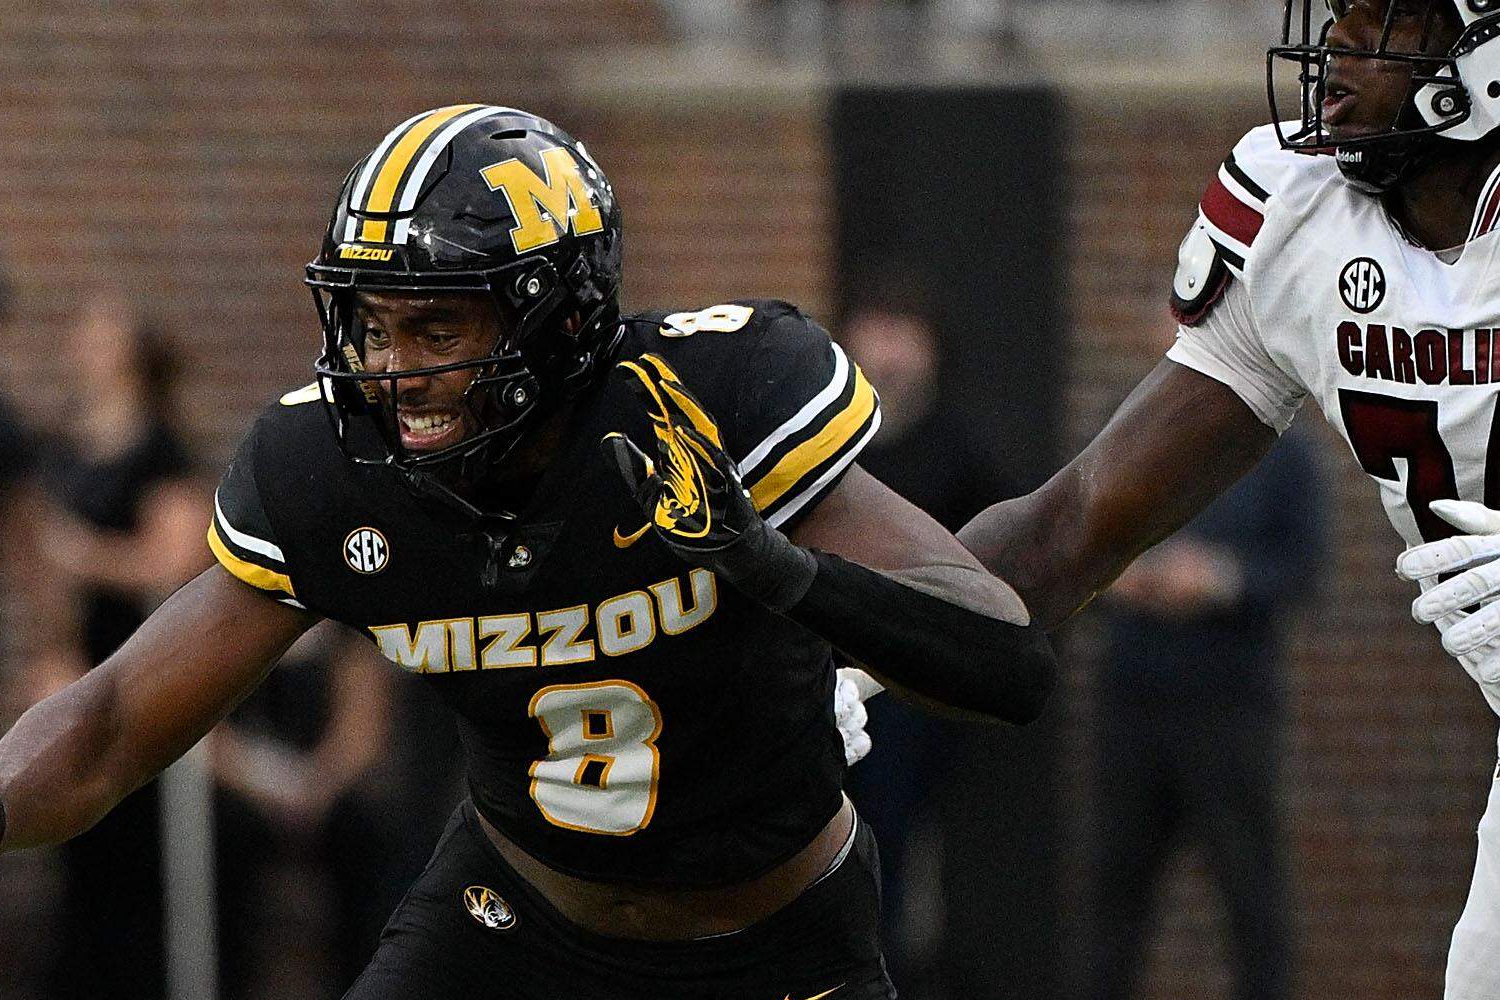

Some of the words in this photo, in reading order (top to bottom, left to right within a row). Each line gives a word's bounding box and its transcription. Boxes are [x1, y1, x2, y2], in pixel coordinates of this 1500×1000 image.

[479, 147, 604, 254] M
[340, 248, 393, 262] MIZZOU
[1343, 262, 1381, 309] SEC
[343, 343, 378, 404] MIZOU
[1338, 388, 1500, 612] 7
[347, 531, 385, 571] SEC
[368, 566, 717, 674] MIZZOU
[528, 678, 662, 836] 8
